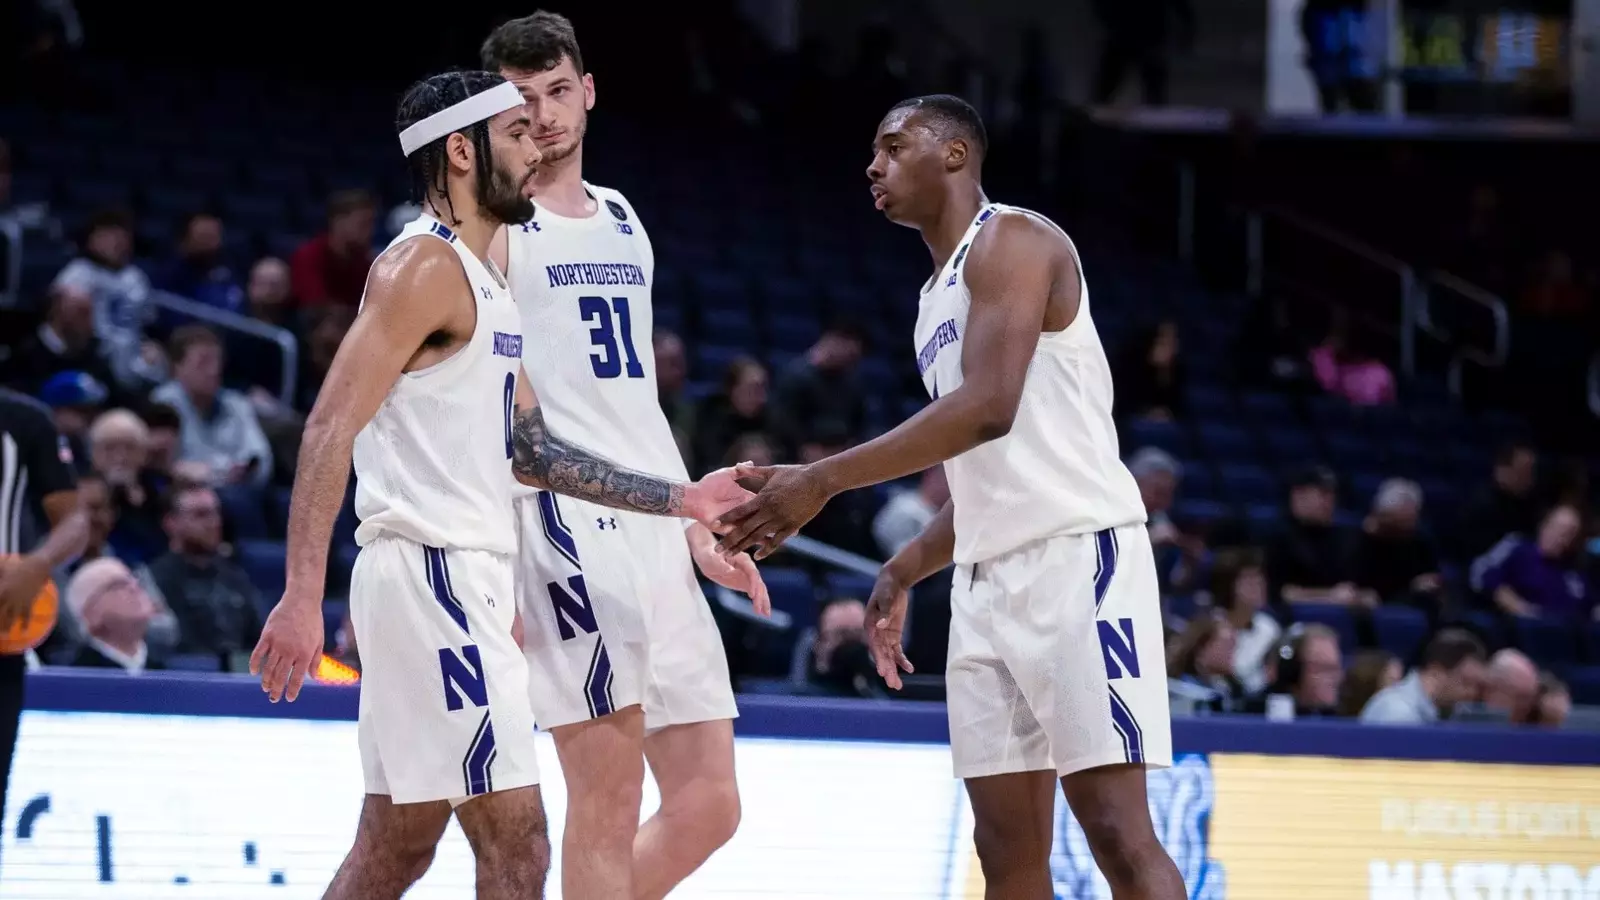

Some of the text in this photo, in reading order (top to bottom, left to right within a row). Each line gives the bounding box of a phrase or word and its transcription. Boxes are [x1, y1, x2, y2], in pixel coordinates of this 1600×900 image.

[546, 263, 646, 287] NORTHWESTERN
[578, 296, 645, 379] 31
[503, 372, 515, 459] 0
[547, 574, 599, 641] N
[439, 644, 489, 712] N
[1096, 618, 1141, 680] N
